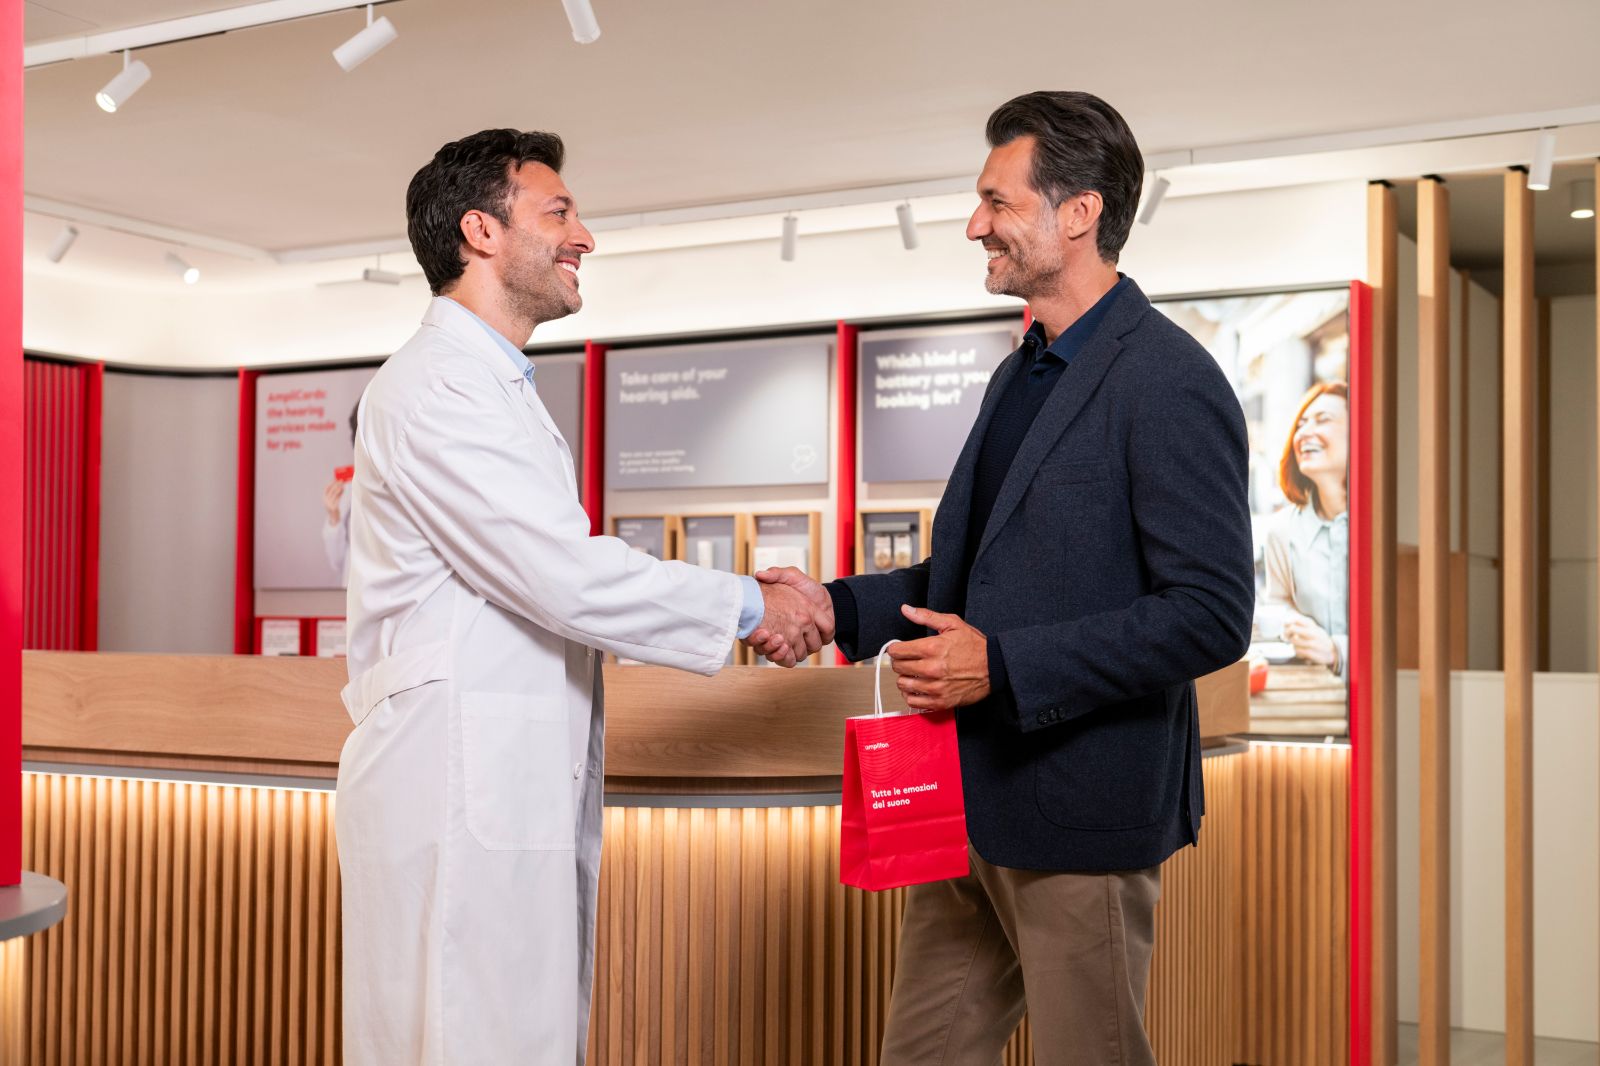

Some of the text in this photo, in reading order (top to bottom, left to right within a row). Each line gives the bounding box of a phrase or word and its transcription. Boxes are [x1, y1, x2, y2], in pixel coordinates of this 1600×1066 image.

[876, 348, 976, 370] Which kind of
[620, 367, 728, 386] Take care of your
[876, 370, 990, 390] battery are you
[620, 387, 669, 405] hearing
[876, 388, 962, 410] looking for?
[266, 406, 324, 419] the hearing
[266, 420, 336, 435] services made
[865, 742, 889, 751] amplifon
[871, 781, 938, 798] Tutte le emozioni
[872, 798, 910, 810] del suono
